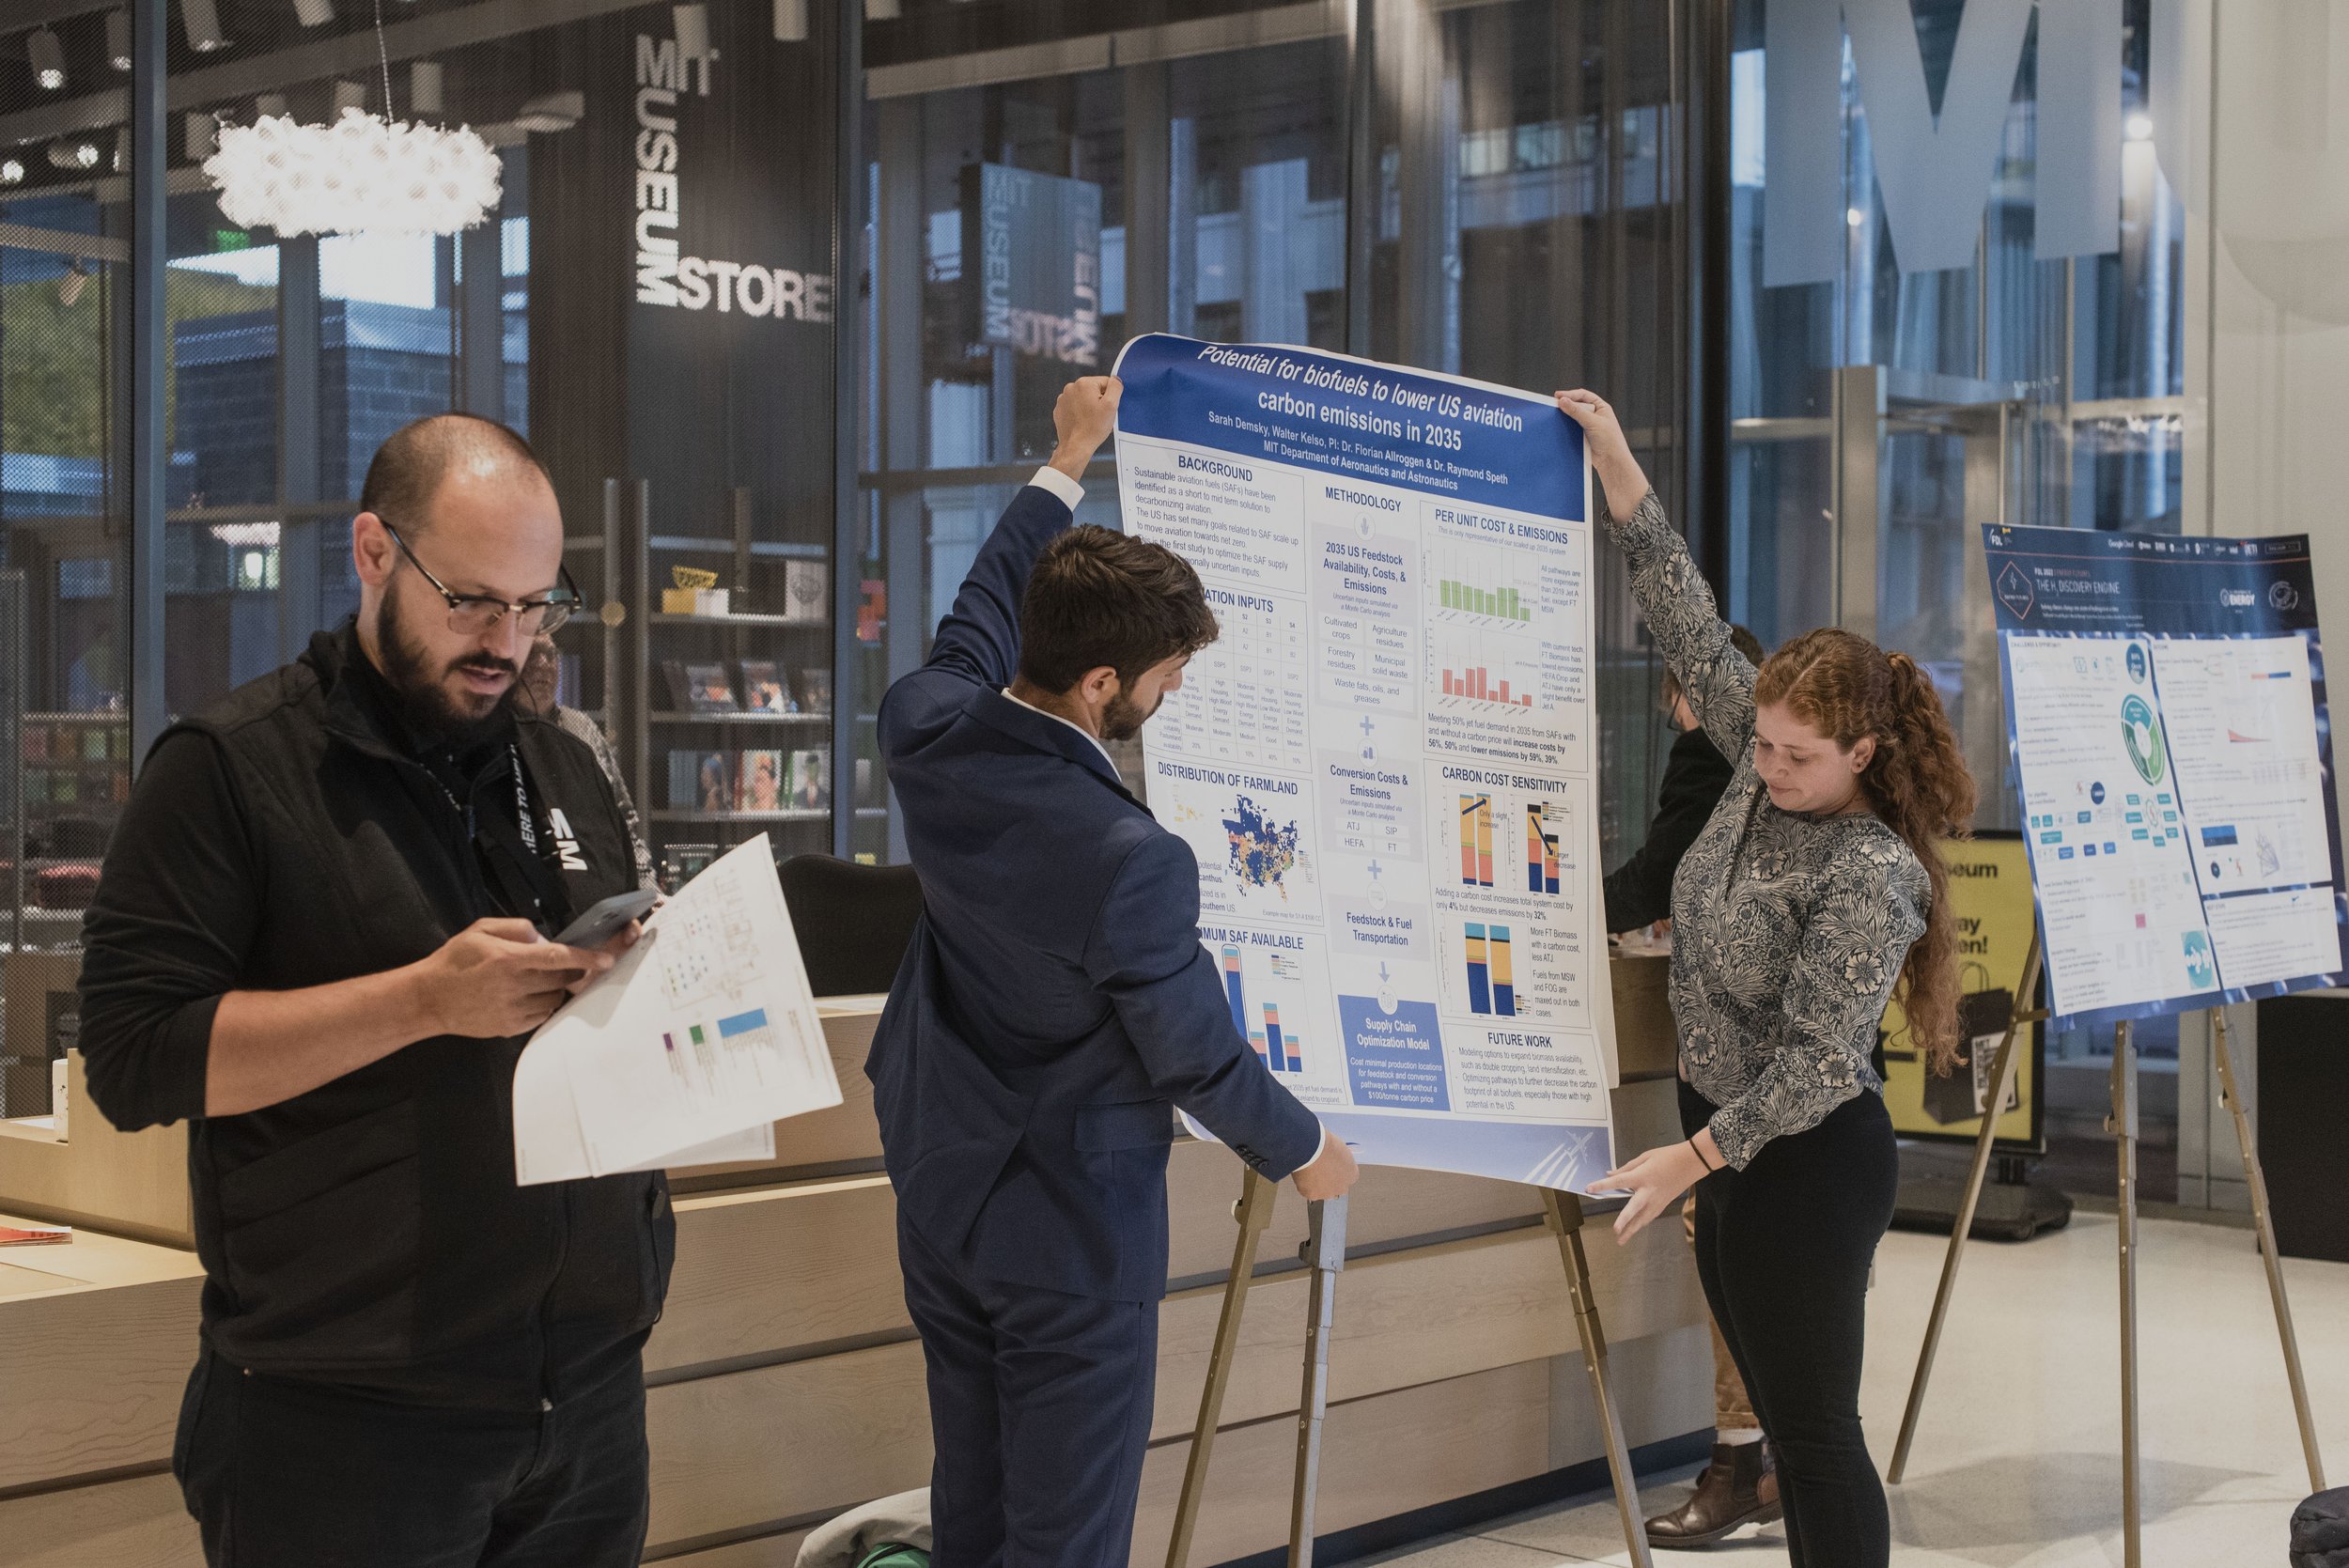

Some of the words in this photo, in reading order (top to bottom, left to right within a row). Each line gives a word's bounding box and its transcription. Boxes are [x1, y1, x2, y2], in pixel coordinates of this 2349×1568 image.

[636, 34, 721, 96] MIT
[1764, 0, 2123, 287] M
[677, 255, 834, 323] STORE
[1197, 345, 1279, 375] Potential
[1276, 358, 1304, 380] for
[1303, 364, 1369, 397] biofuels
[1372, 380, 1389, 401] to
[1391, 382, 1436, 412] lower
[1438, 393, 1461, 418] US
[1463, 403, 1522, 433] aviation
[1258, 391, 1315, 420] carbon
[1320, 405, 1402, 439] emissions
[1407, 419, 1421, 442] in
[1424, 423, 1462, 451] 2035
[1208, 411, 1234, 427] Sarah
[1235, 416, 1269, 438] Demsky,
[1271, 425, 1299, 441] Walter
[1300, 431, 1327, 449] Kelso,
[1329, 437, 1339, 450] PI:
[1342, 440, 1353, 453] Dr.
[1355, 443, 1383, 459] Florian
[1385, 450, 1424, 468] Allroggen
[1425, 458, 1432, 469] &
[1434, 459, 1445, 473] Dr.
[1447, 462, 1485, 480] Raymond
[1486, 470, 1508, 485] Speth
[1177, 455, 1252, 482] BACKGROUND
[1264, 440, 1279, 454] MIT
[1281, 443, 1329, 465] Department
[1330, 455, 1339, 467] of
[1340, 457, 1389, 477] Aeronautics
[1391, 468, 1407, 480] and
[1408, 470, 1458, 490] Astronautics
[1134, 466, 1176, 482] Sustainable
[1177, 474, 1204, 486] aviation
[1205, 479, 1221, 489] fuels
[1244, 487, 1260, 498] have
[1260, 491, 1276, 502] been
[1134, 480, 1166, 494] identified
[1168, 486, 1177, 495] as
[1178, 487, 1184, 495] a
[1185, 489, 1203, 500] short
[1203, 491, 1210, 501] to
[1211, 492, 1222, 504] mid
[1223, 496, 1238, 506] term
[1239, 499, 1263, 512] solution
[1264, 505, 1271, 514] to
[1135, 494, 1184, 511] decarbonizing
[1185, 503, 1212, 515] aviation.
[1325, 487, 1402, 513] METHODOLOGY
[1136, 506, 1149, 518] The
[1150, 509, 1161, 520] US
[1162, 511, 1176, 522] has
[1177, 515, 1190, 524] set
[1190, 518, 1209, 529] many
[1210, 520, 1227, 534] goals
[1228, 523, 1250, 536] related
[1251, 528, 1257, 537] to
[1258, 529, 1271, 539] SAF
[1272, 532, 1289, 543] scale
[1290, 537, 1299, 546] up
[1435, 508, 1455, 523] PER
[1456, 513, 1479, 528] UNIT
[1480, 518, 1506, 534] COST
[1508, 522, 1516, 536] &
[1517, 524, 1568, 545] EMISSIONS
[1326, 541, 1346, 555] 2035
[1347, 546, 1360, 557] US
[1361, 548, 1404, 566] Feedstock
[1323, 558, 1371, 578] Availability,
[1372, 567, 1398, 582] Costs,
[1400, 571, 1407, 582] &
[1344, 578, 1387, 596] Emissions
[1205, 588, 1236, 606] ATION
[1237, 595, 1274, 613] INPUTS
[1324, 615, 1358, 629] Cultivated
[1372, 625, 1408, 638] Agriculture
[1331, 630, 1351, 640] crops
[1376, 637, 1405, 649] residues
[1328, 646, 1356, 660] Forestry
[1375, 654, 1406, 666] Municipal
[1327, 659, 1356, 671] residues
[1372, 667, 1388, 675] solid
[1389, 671, 1408, 679] waste
[1334, 677, 1356, 689] Waste
[1356, 681, 1371, 691] fats,
[1372, 685, 1386, 694] oils,
[1387, 687, 1400, 696] and
[1353, 693, 1381, 705] greases
[1427, 712, 1452, 726] Meeting
[1452, 716, 1466, 727] 50%
[1474, 720, 1486, 729] fuel
[1486, 722, 1509, 733] demand
[1517, 726, 1532, 737] 2035
[1532, 729, 1545, 737] from
[1546, 730, 1563, 740] SAFs
[1563, 732, 1577, 741] with
[1158, 761, 1225, 785] DISTRIBUTION
[1227, 773, 1240, 787] OF
[1243, 775, 1299, 796] FARMLAND
[1330, 764, 1376, 782] Conversion
[1377, 771, 1400, 784] Costs
[1402, 775, 1408, 785] &
[1442, 766, 1483, 784] CARBON
[1484, 771, 1509, 786] COST
[1512, 777, 1567, 794] SENSITIVITY
[1349, 784, 1392, 800] Emissions
[1346, 821, 1361, 831] ATJ
[1385, 826, 1398, 835] SIP
[1344, 837, 1365, 848] HEFA
[1388, 843, 1397, 852] FT
[1346, 911, 1386, 927] Feedstock
[1388, 916, 1394, 927] &
[1395, 917, 1413, 930] Fuel
[1200, 926, 1227, 942] IMUM
[1229, 929, 1249, 944] SAF
[1251, 933, 1304, 950] AVAILABLE
[1352, 929, 1408, 946] Transportation
[1365, 1017, 1392, 1033] Supply
[1393, 1019, 1417, 1033] Chain
[1357, 1033, 1406, 1049] Optimization
[1407, 1037, 1430, 1051] Model
[1487, 1032, 1523, 1047] FUTURE
[1524, 1034, 1552, 1048] WORK
